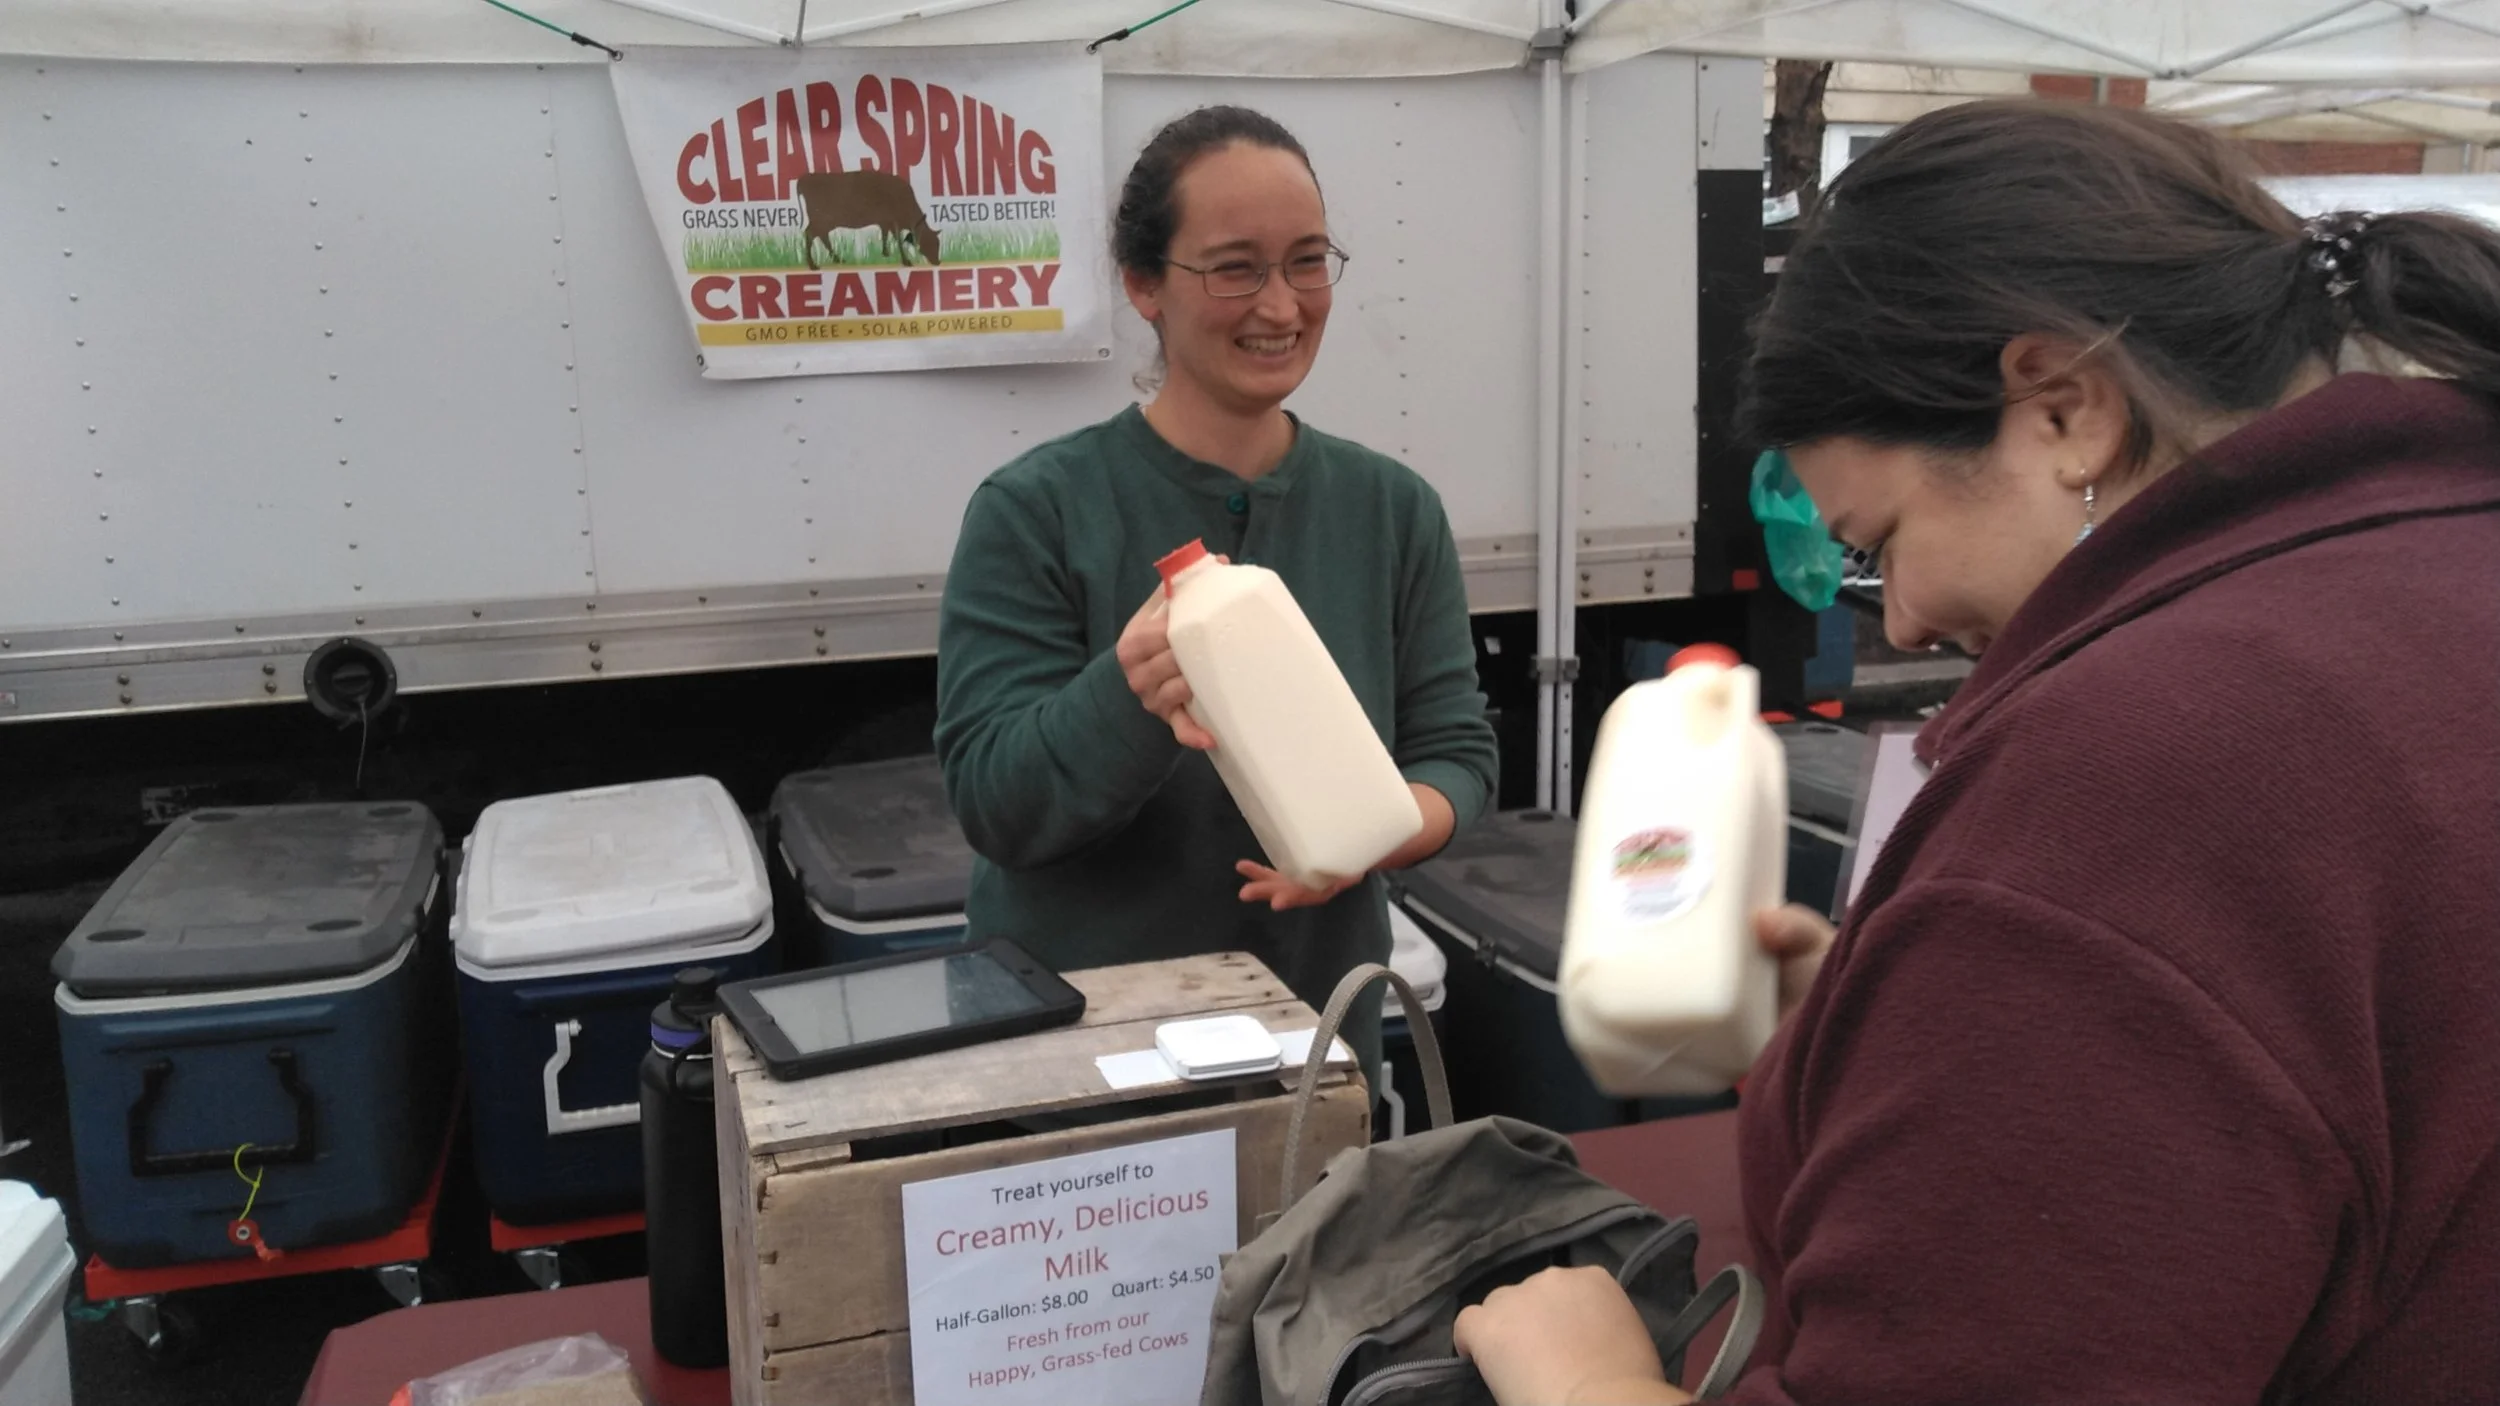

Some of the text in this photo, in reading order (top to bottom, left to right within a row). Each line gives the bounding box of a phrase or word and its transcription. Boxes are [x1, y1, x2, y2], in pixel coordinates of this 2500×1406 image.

[677, 74, 1057, 204] CLEAR SPRING
[683, 200, 1056, 229] GRASS NEVER TASTED BETTER!
[691, 264, 1061, 322] CREAMERY
[745, 315, 1013, 342] GMO FREE SOLAR POWERED
[992, 1164, 1154, 1204] Treat yourself to
[936, 1188, 1209, 1256] Creamy, Delicious
[1045, 1246, 1109, 1281] Milk
[936, 1265, 1215, 1332] Half-Gallon: $8.00 Quart: $4.50
[1007, 1312, 1150, 1351] Fresh from our
[969, 1330, 1189, 1388] Happy, Grass-fed Cows
